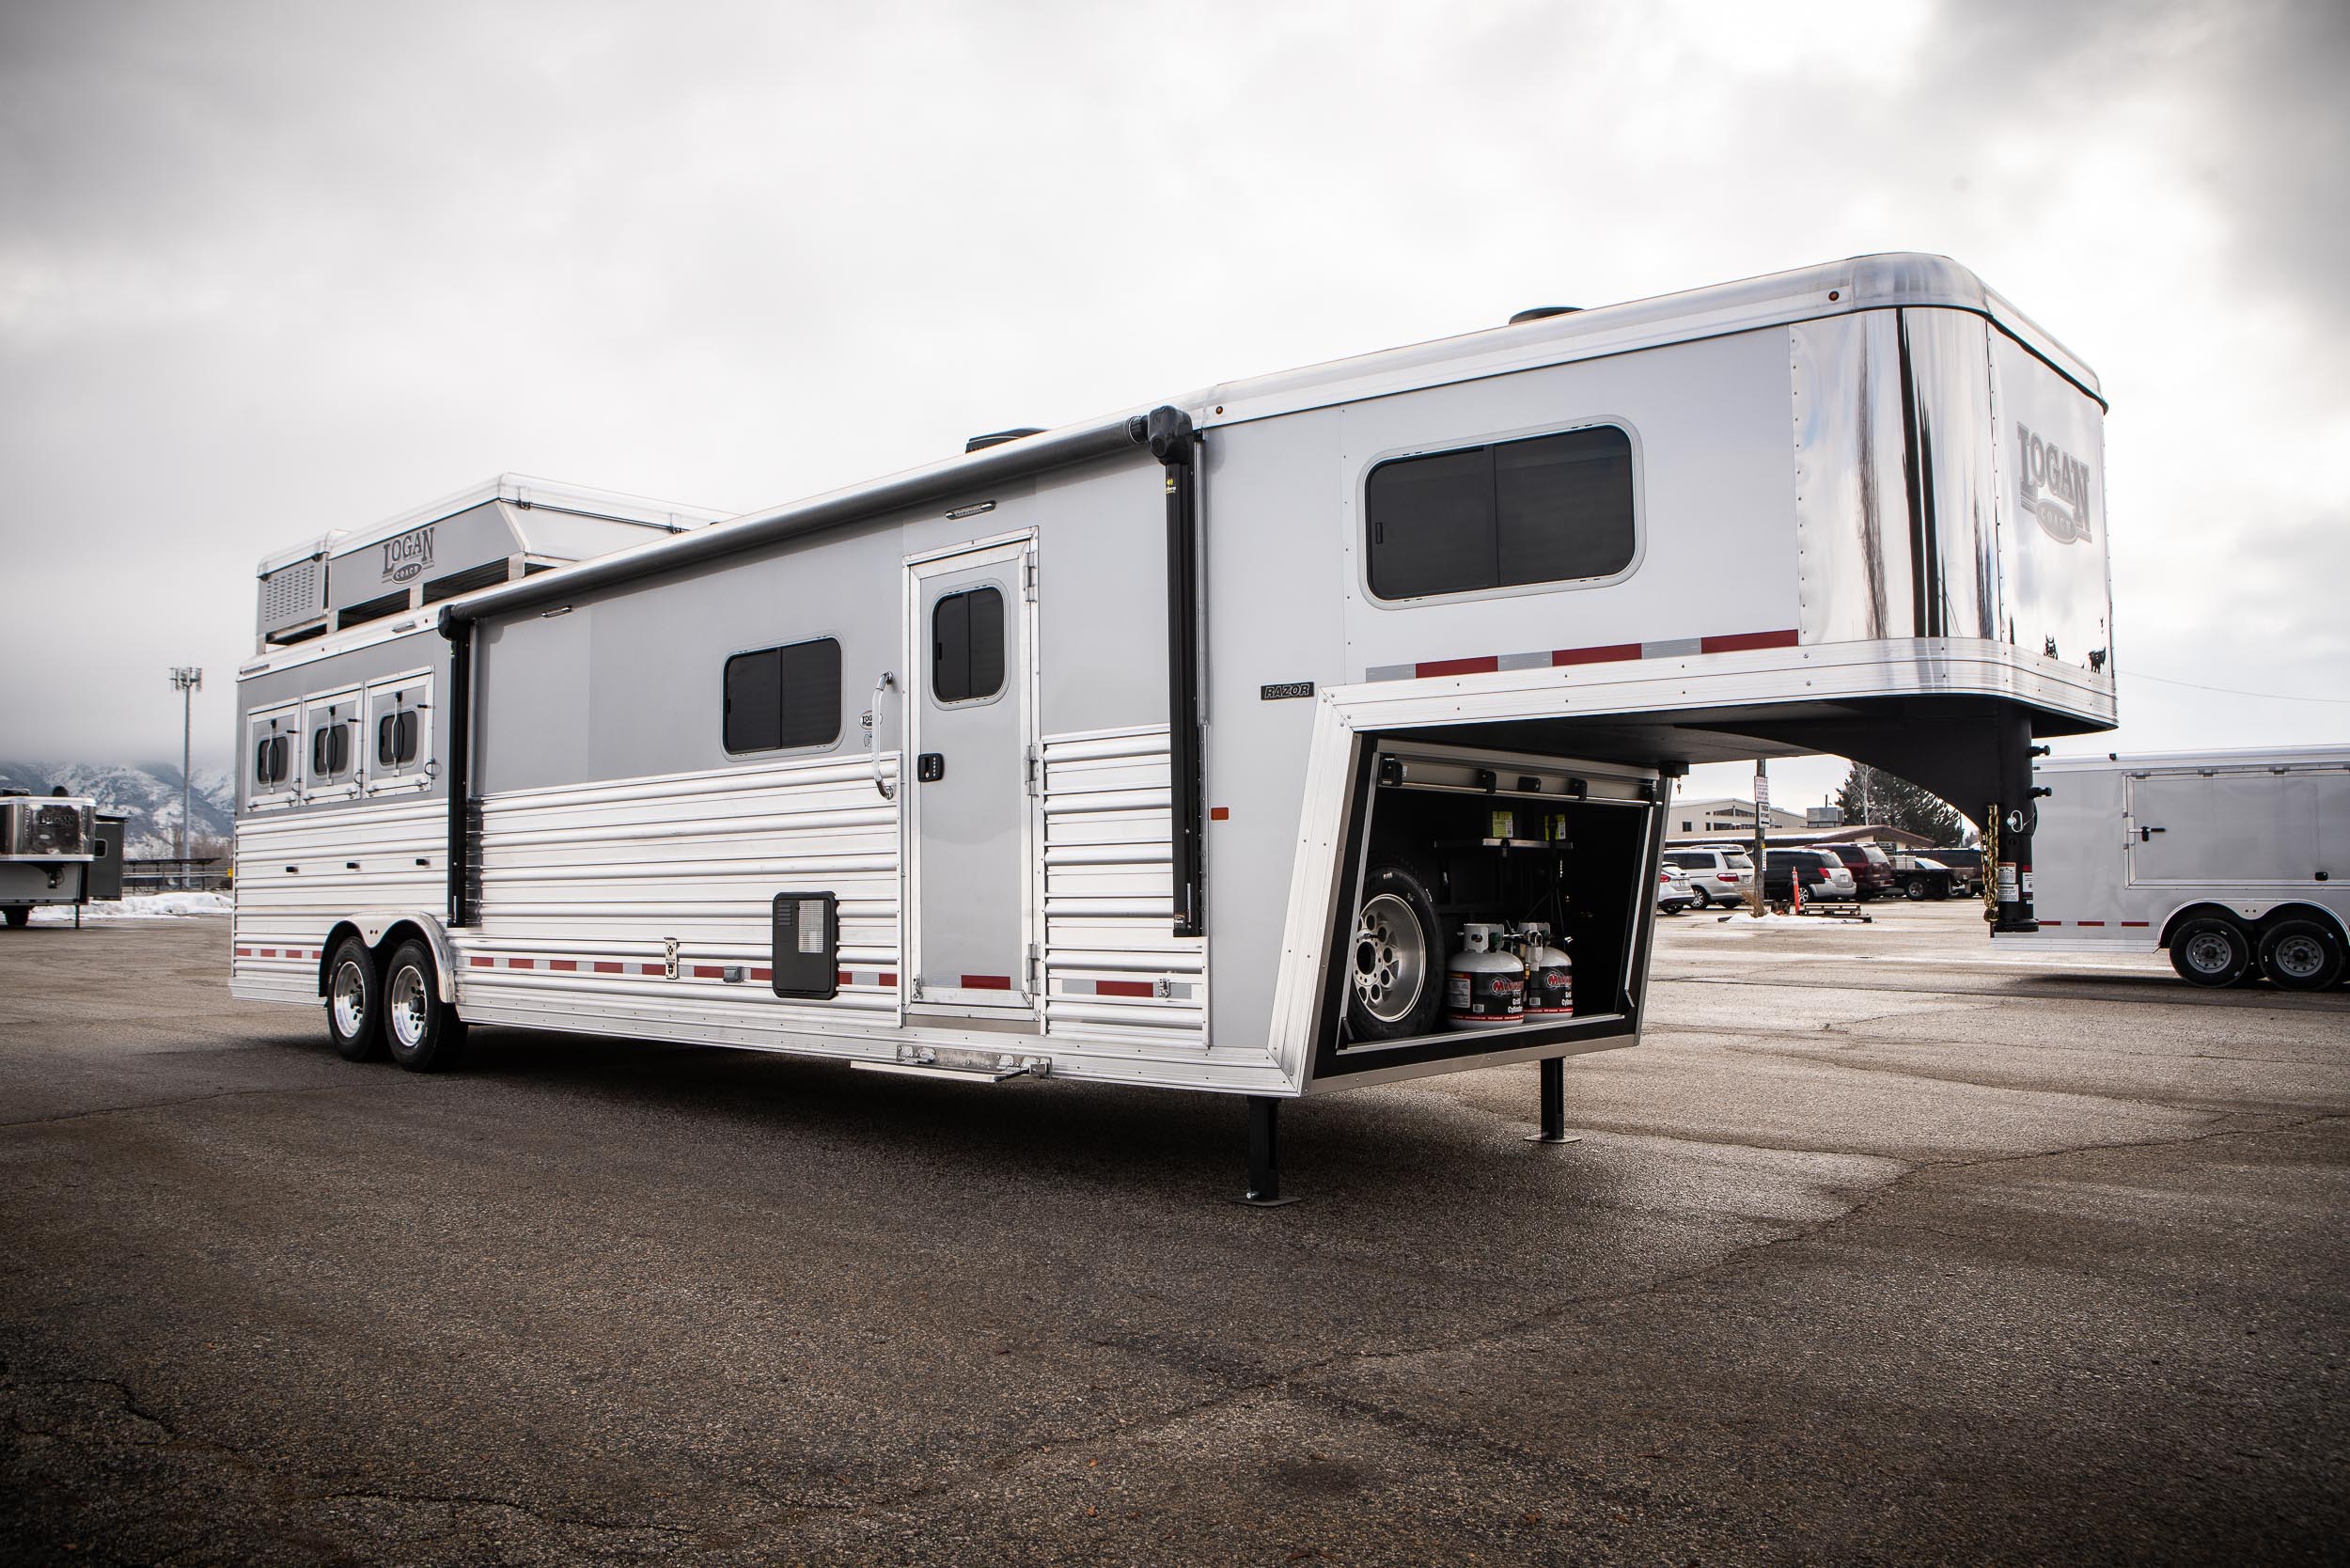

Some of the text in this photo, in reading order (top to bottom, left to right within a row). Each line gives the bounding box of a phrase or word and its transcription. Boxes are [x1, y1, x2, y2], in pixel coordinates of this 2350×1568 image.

[2016, 422, 2090, 533] LOGAN
[2040, 509, 2072, 531] COACH
[382, 525, 435, 575] LOGAN
[395, 565, 419, 579] COACH
[1263, 683, 1310, 698] RAZOR
